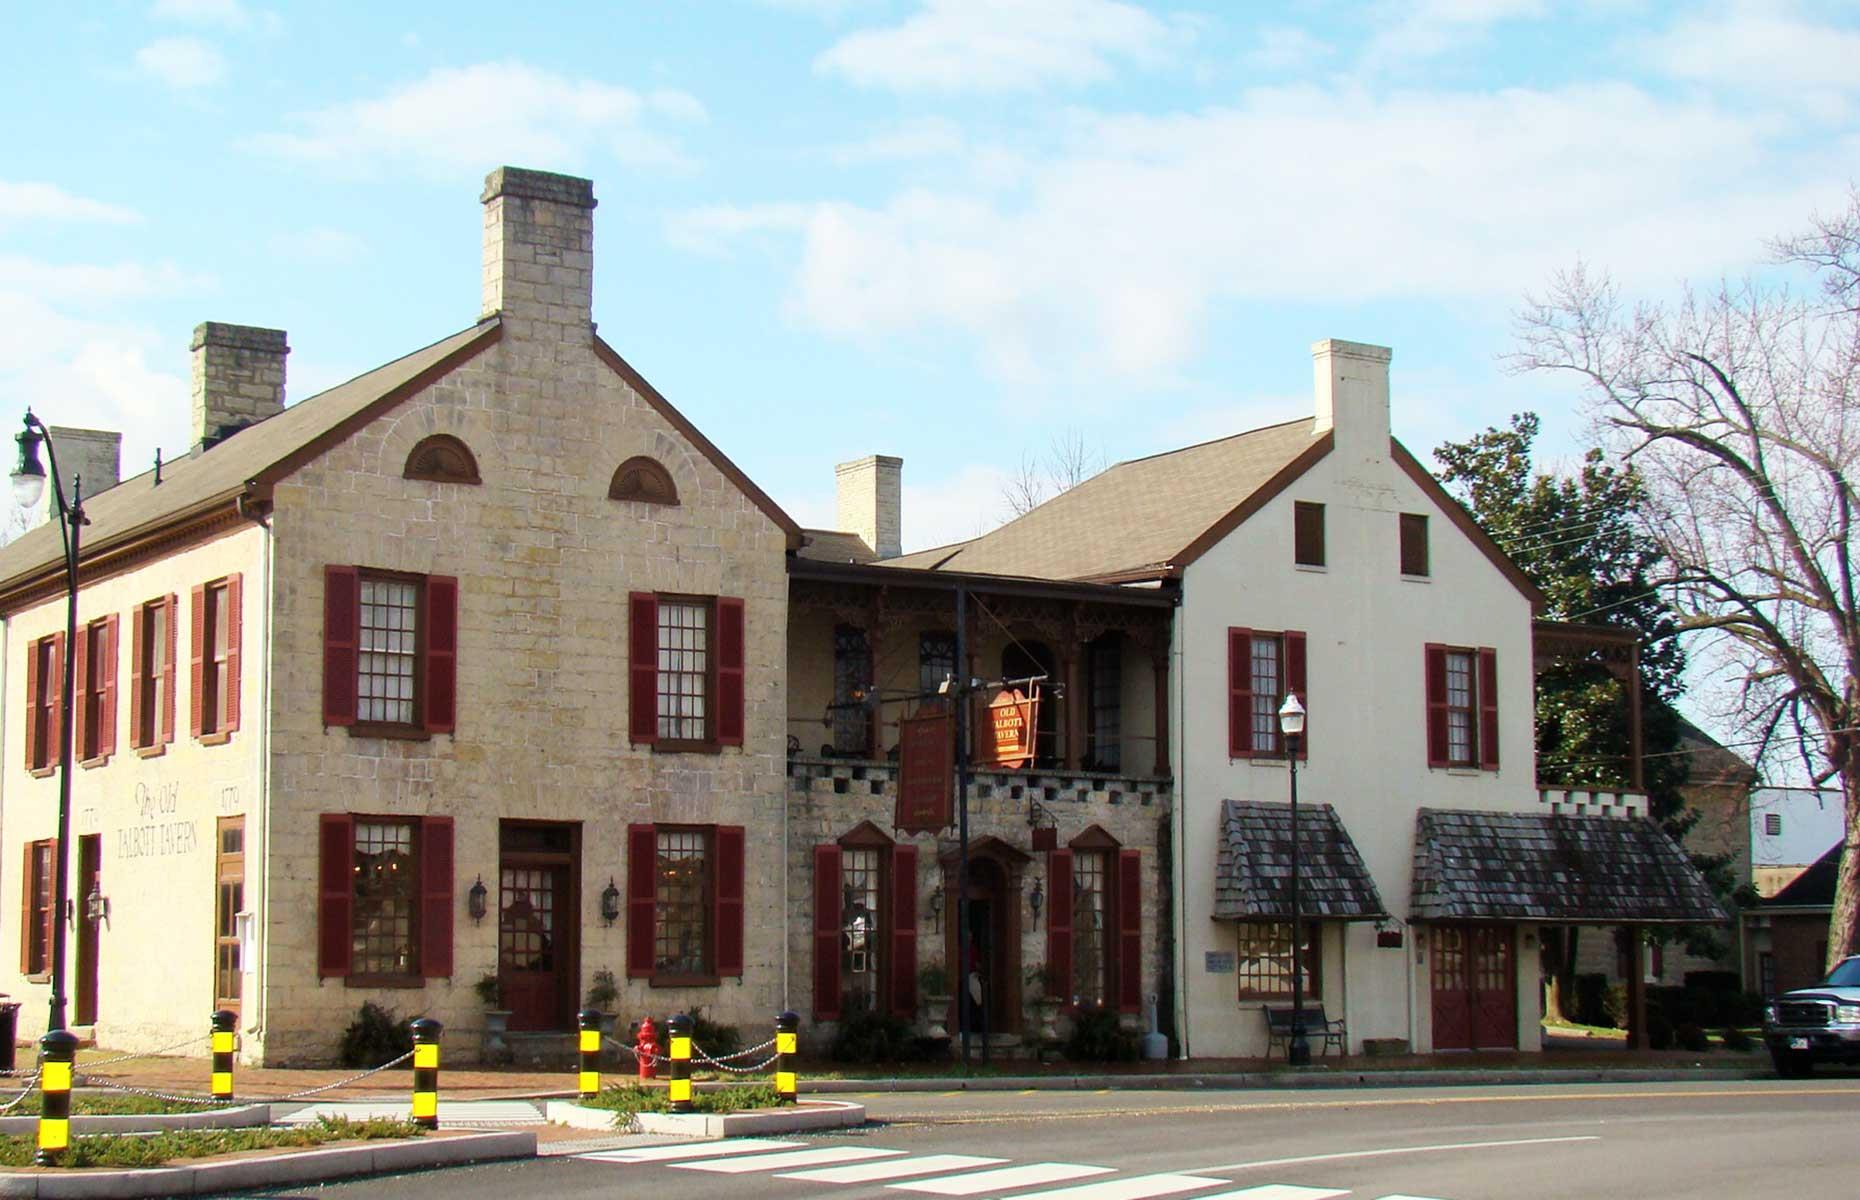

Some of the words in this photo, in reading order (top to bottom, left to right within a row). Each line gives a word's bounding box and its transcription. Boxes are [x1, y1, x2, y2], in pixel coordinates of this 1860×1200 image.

[1000, 707, 1016, 718] OLD
[159, 780, 179, 814] Old
[117, 825, 156, 859] TALBOTT
[160, 819, 198, 856] TAVERN
